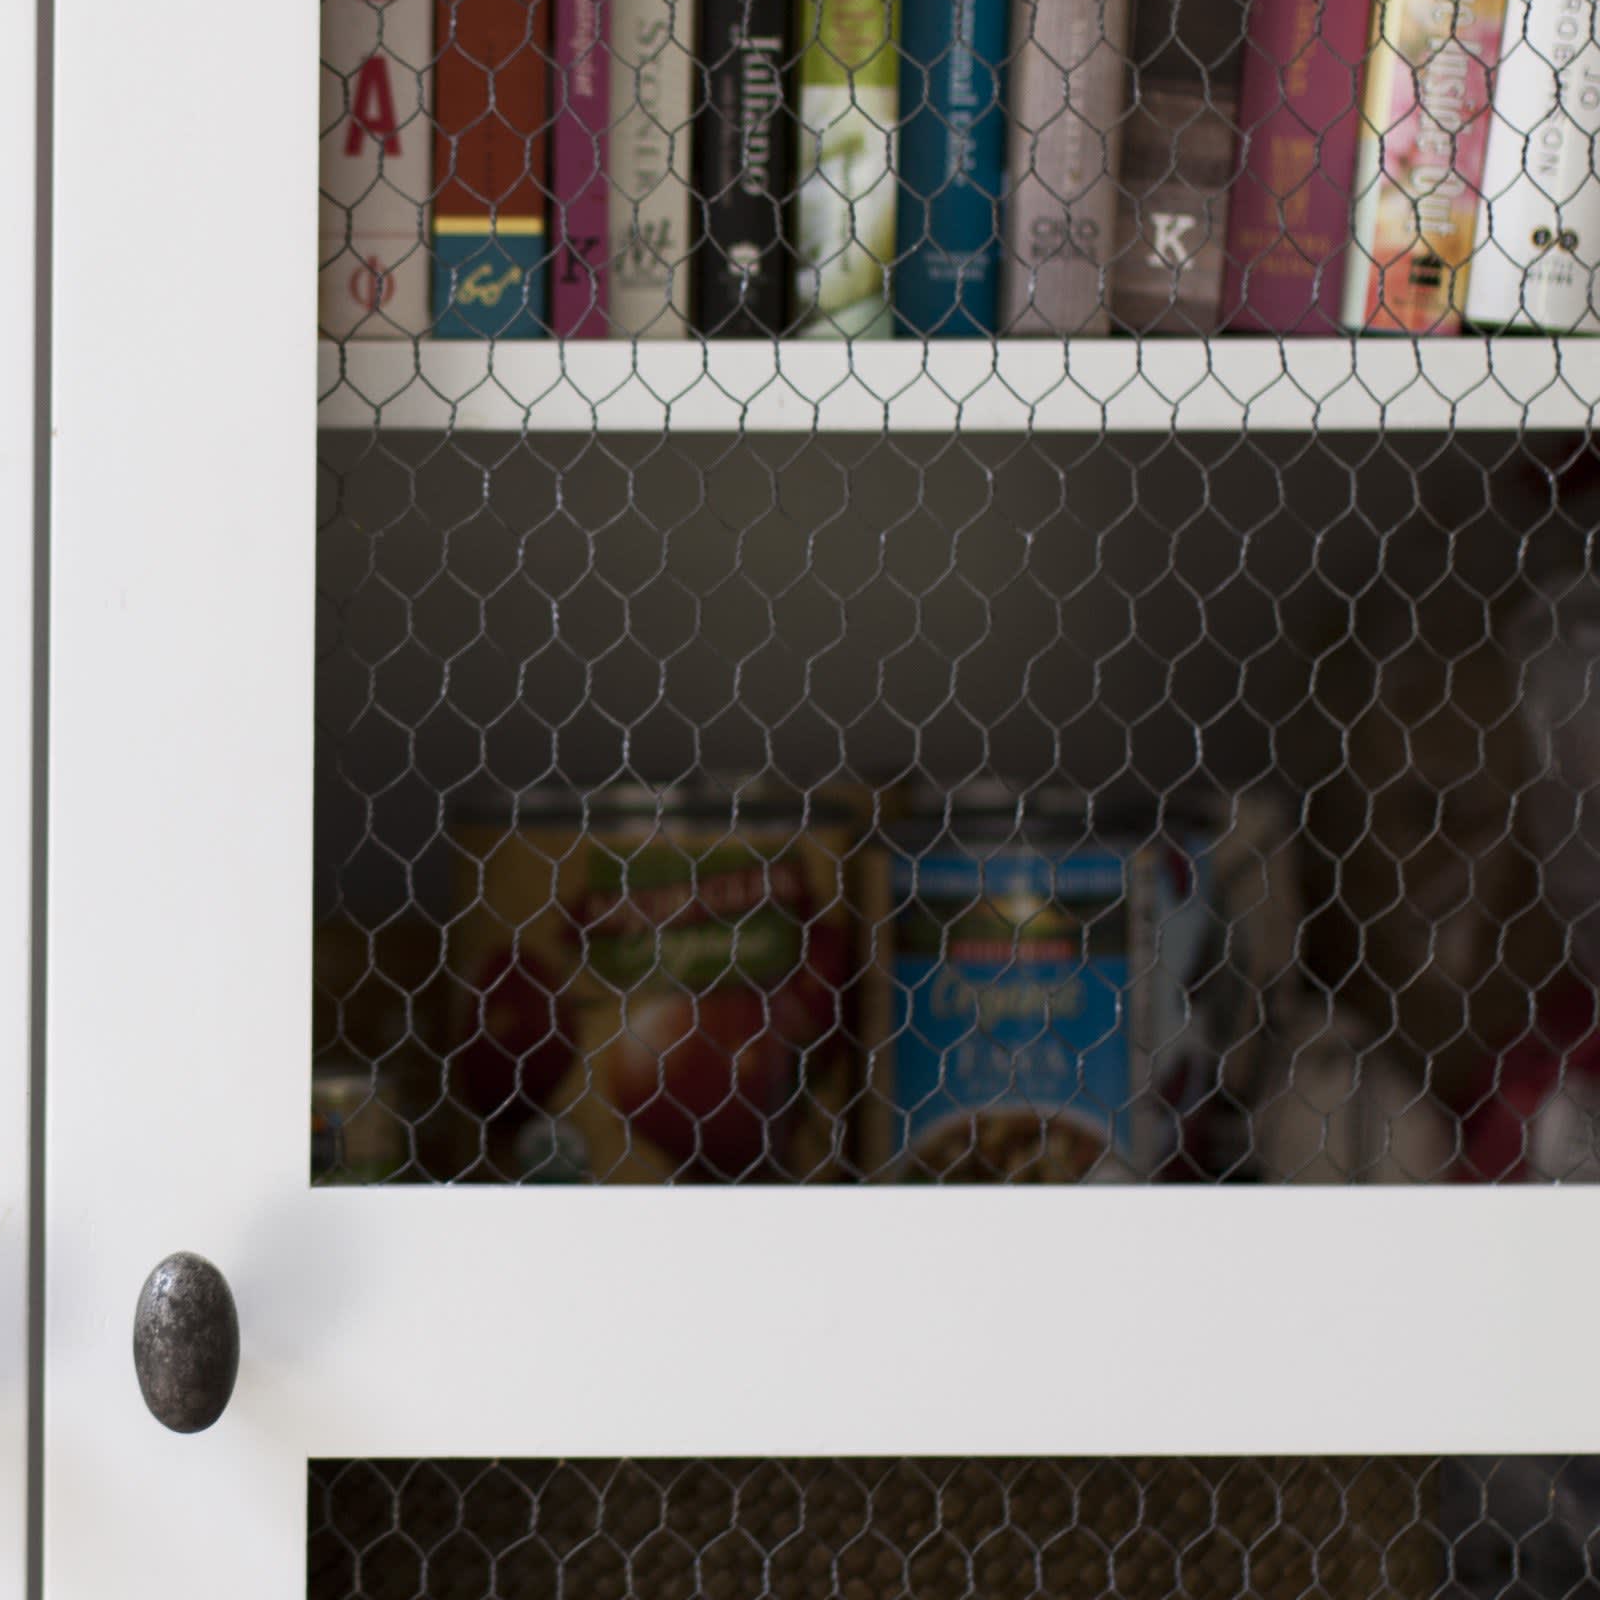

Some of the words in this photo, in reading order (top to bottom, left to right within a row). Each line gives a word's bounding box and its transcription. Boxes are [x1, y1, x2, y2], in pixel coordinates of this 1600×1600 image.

[1418, 36, 1484, 153] Inside
[1407, 164, 1466, 237] Out
[1146, 213, 1196, 270] K
